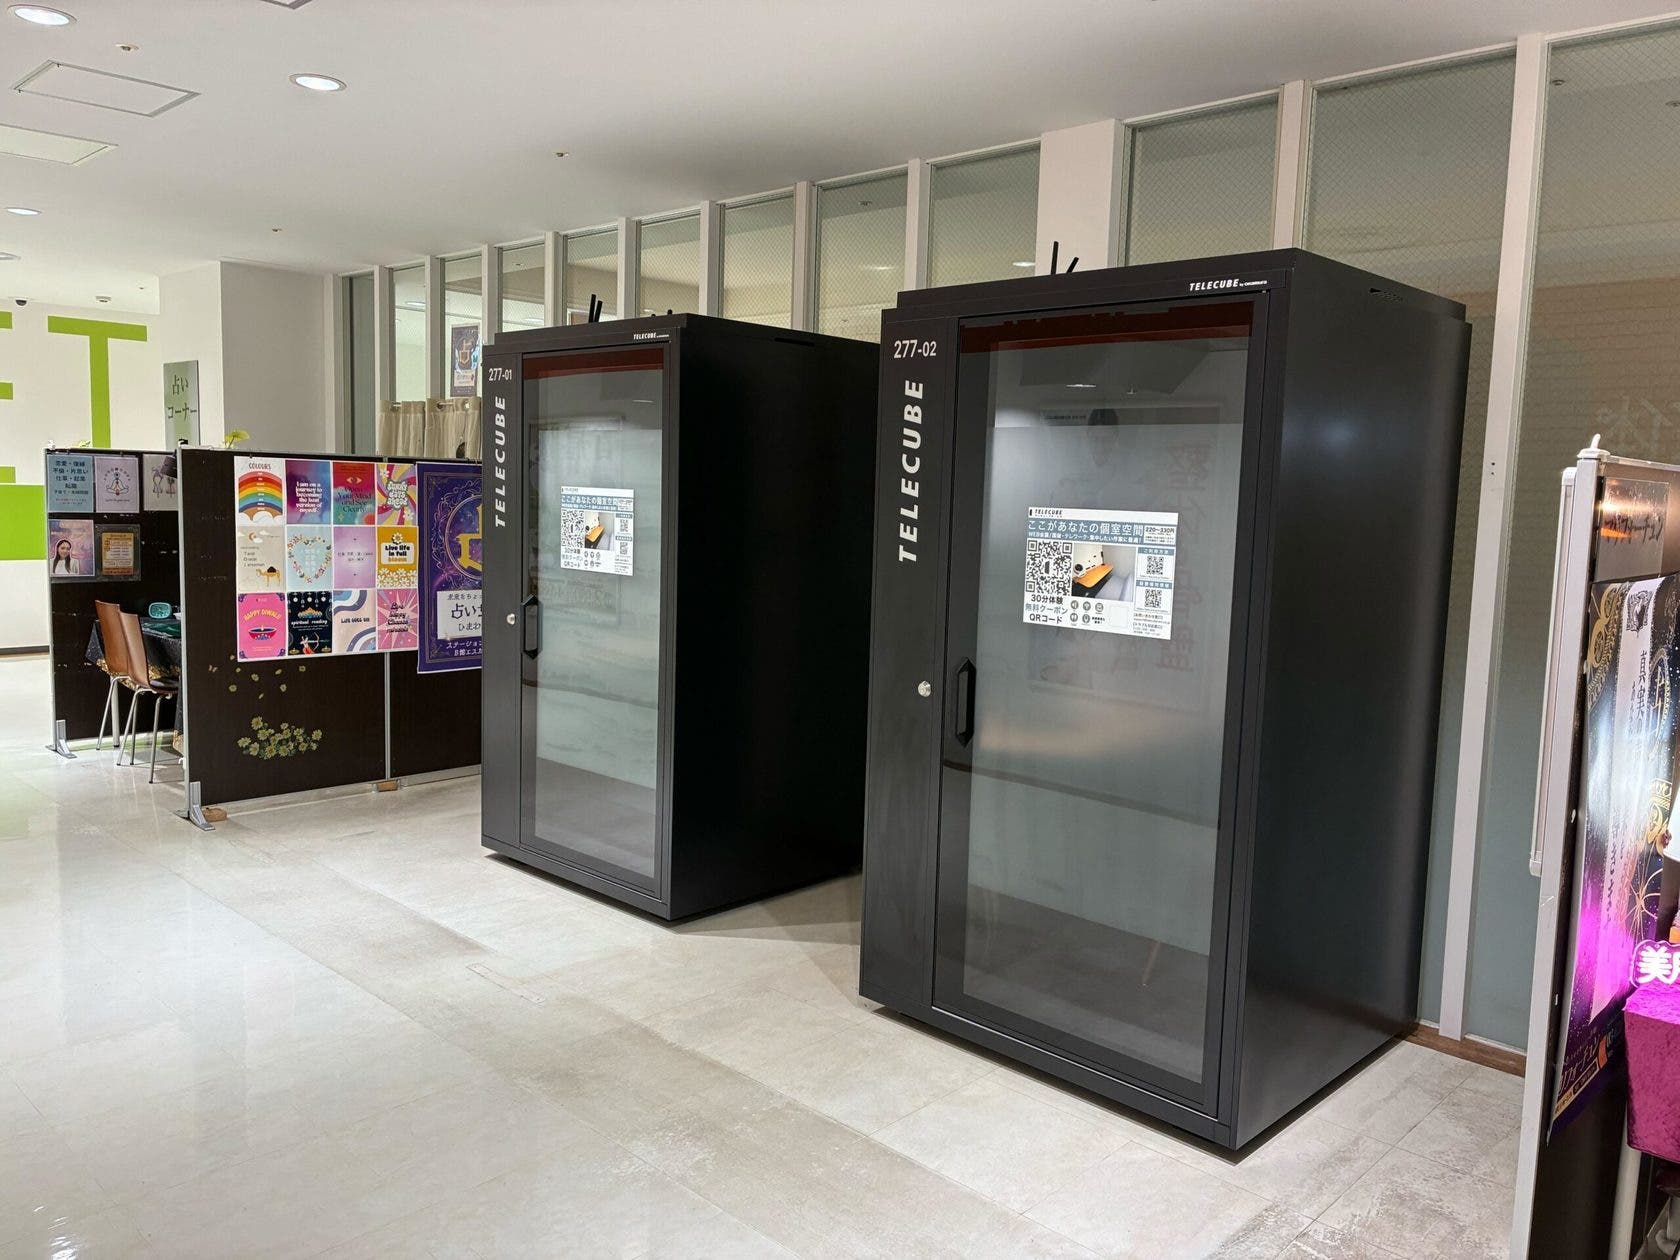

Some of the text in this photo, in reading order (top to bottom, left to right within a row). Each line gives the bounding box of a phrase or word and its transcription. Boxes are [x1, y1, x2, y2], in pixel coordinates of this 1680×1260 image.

[1189, 279, 1239, 291] TELECUBE
[893, 340, 937, 359] 277-02
[488, 368, 512, 382] 277-01
[172, 374, 188, 396] 占い
[168, 402, 197, 421] コーナー
[248, 462, 271, 470] COLOURS
[494, 396, 506, 528] TELECUBE
[898, 380, 924, 562] TELECUBE
[1028, 520, 1144, 536] ここがあなたの個室空間
[1031, 594, 1064, 605] 30分体験
[243, 609, 261, 620] HAPPY
[1025, 603, 1068, 615] 無料クーポン
[1030, 614, 1062, 624] QRコード
